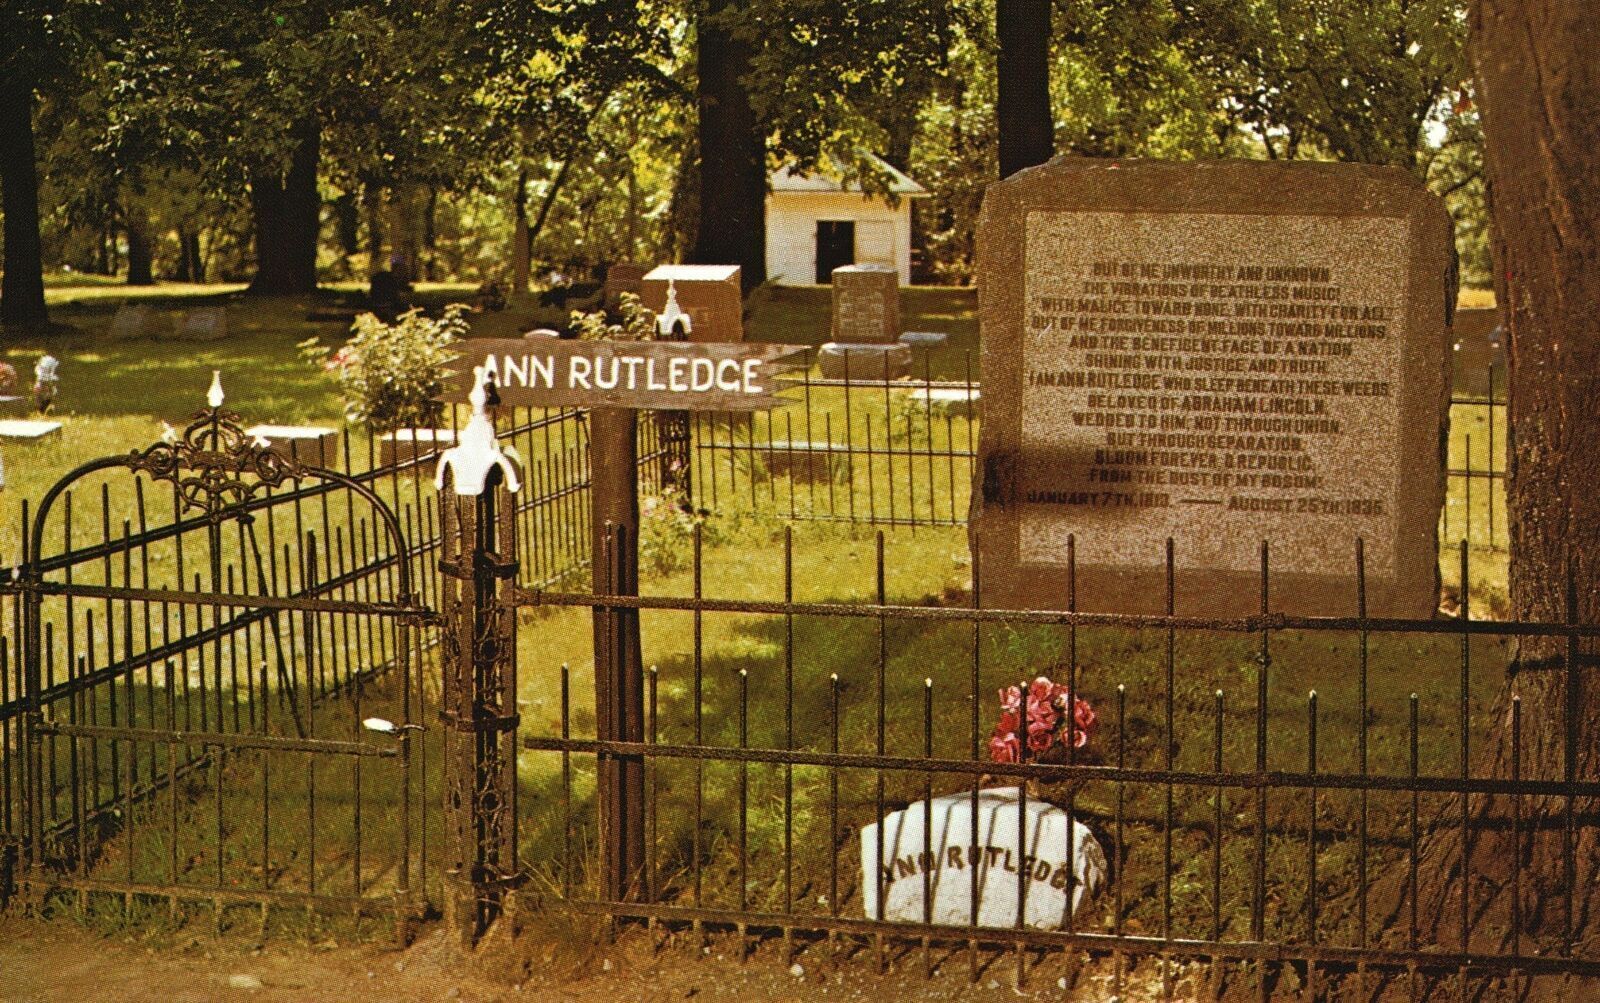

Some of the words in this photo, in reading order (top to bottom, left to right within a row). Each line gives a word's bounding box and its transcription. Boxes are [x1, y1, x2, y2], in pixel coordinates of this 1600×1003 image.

[1093, 263, 1118, 277] OUT
[1121, 264, 1137, 277] OF
[1140, 264, 1161, 278] ME
[1236, 266, 1263, 281] AND
[1265, 267, 1330, 282] UNKNOWN
[1084, 282, 1107, 295] THE
[1190, 284, 1207, 297] OF
[1078, 300, 1132, 314] MALICE
[1134, 301, 1192, 315] TOWARD
[1234, 303, 1267, 317] WITH
[1269, 304, 1329, 319] CHARITY
[1331, 305, 1359, 320] FOR
[1031, 316, 1058, 330] OUT
[1060, 317, 1077, 331] OF
[1078, 317, 1099, 332] ME
[1100, 318, 1186, 334] FORGIVENESS
[1187, 320, 1205, 334] OF
[1207, 320, 1266, 336] MILLIONS
[1269, 322, 1323, 337] TOWARD
[1325, 323, 1386, 339] MILLIONS
[1069, 335, 1098, 350] AND
[1101, 336, 1129, 350] THE
[1132, 337, 1219, 353] BENEFICENT
[1222, 339, 1260, 354] FACE
[1263, 340, 1283, 355] OF
[1285, 341, 1295, 355] A
[1298, 341, 1352, 357] NATION
[1085, 353, 1141, 368] SHINING
[1144, 355, 1182, 370] WITH
[1184, 356, 1244, 372] JUSTICE
[1249, 358, 1277, 373] AND
[481, 354, 555, 389] ANN
[569, 355, 764, 394] RUTLEDGE
[1036, 372, 1056, 387] AM
[1057, 372, 1085, 387] ANN
[1087, 372, 1162, 389] RUTLEDGE
[1164, 377, 1191, 391] WHO
[1194, 378, 1234, 392] SLEEP
[1236, 379, 1295, 394] BENEATH
[1297, 380, 1341, 395] THESE
[1087, 394, 1158, 410] BELOVED
[1159, 396, 1179, 411] OF
[1181, 396, 1257, 413] ABRAHAM
[1072, 412, 1136, 428] WEDDED
[1137, 413, 1158, 429] TO
[1194, 416, 1222, 431] NOT
[1224, 416, 1293, 434] THROUGH
[1107, 432, 1136, 447] BUT
[1138, 432, 1206, 449] THROUGH
[1095, 449, 1148, 466] BLOOM
[1088, 468, 1132, 484] FROM
[1137, 470, 1168, 485] THE
[1169, 470, 1210, 486] DUST
[1212, 472, 1234, 487] OF
[1235, 473, 1259, 488] MY
[1026, 489, 1098, 505] JANUARY
[1227, 495, 1295, 513] AUGUST
